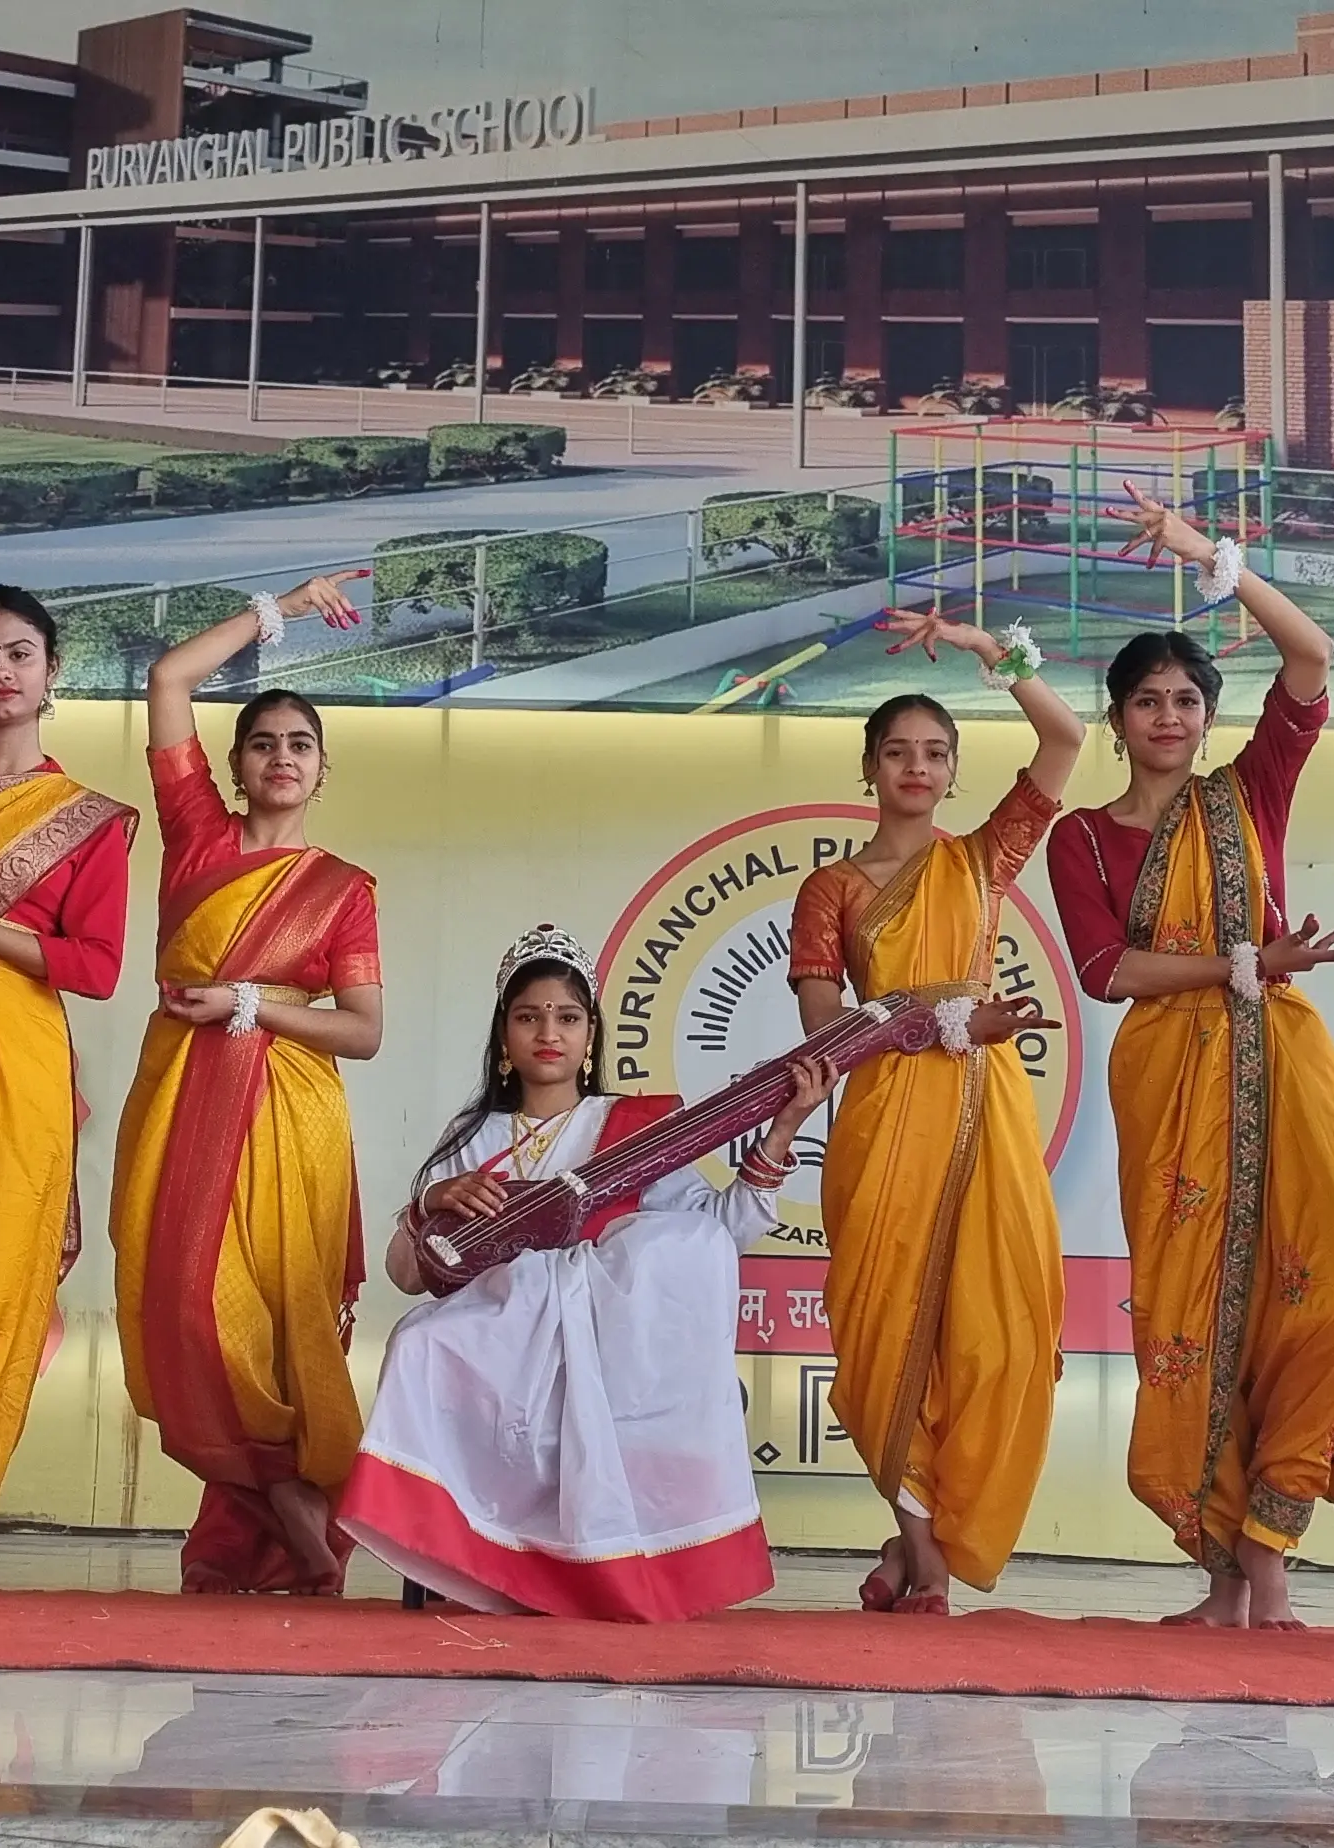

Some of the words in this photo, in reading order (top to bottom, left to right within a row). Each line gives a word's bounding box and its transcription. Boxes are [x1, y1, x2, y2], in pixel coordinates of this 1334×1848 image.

[85, 128, 273, 190] PURVANCHAL
[283, 113, 416, 173] PUBLIC
[425, 86, 606, 160] SCHOOL
[616, 845, 799, 1081] PURVANCHAL
